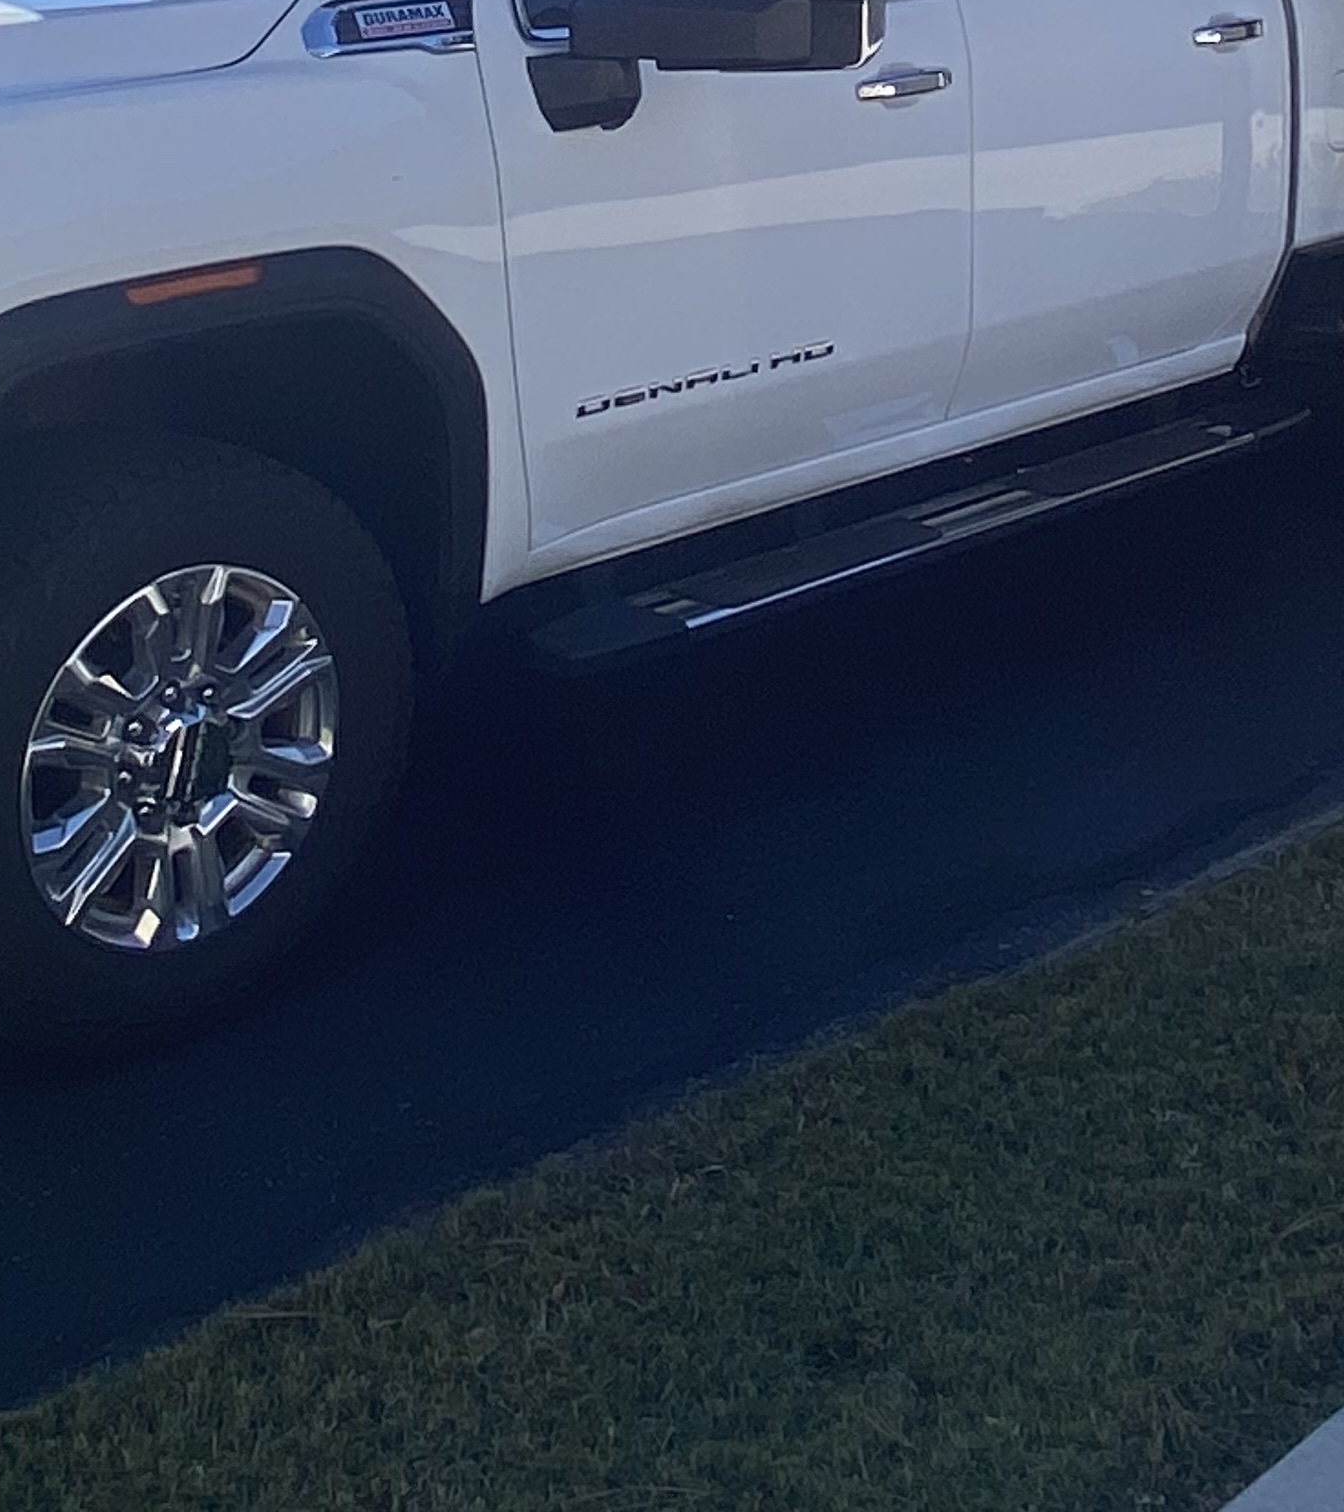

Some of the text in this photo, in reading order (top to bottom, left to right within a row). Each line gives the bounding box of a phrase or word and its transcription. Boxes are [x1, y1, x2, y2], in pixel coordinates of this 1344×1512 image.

[362, 3, 446, 27] DURAMAX
[575, 339, 835, 418] DENALI HD
